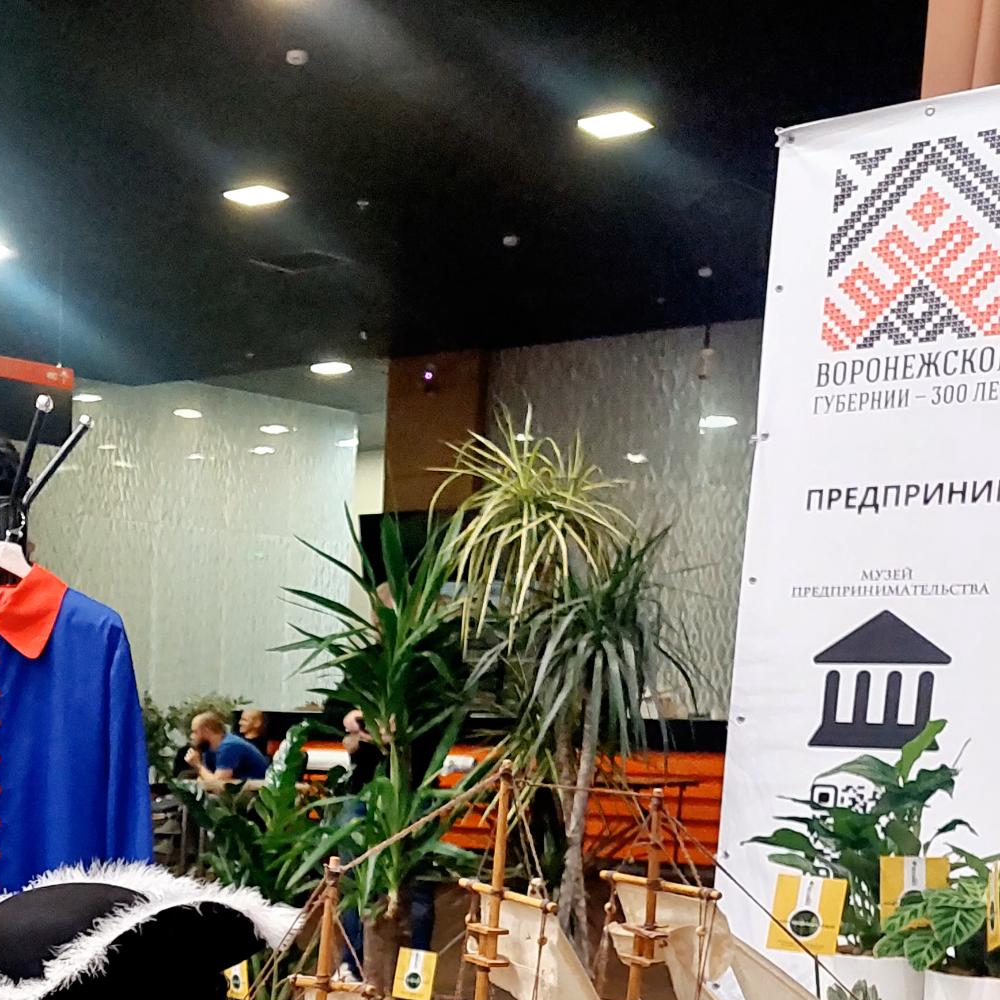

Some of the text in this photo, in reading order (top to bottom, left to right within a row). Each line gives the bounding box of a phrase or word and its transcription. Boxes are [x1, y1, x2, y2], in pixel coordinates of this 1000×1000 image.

[815, 346, 1000, 388] ВОРОНЕЖСКО
[813, 388, 910, 415] ГУБЕРНИИ
[931, 383, 968, 406] 300
[806, 479, 1000, 515] ПРЕДПРИНИ
[860, 566, 913, 582] МУЗЕЙ
[791, 583, 990, 599] ПРЕДПРИНИМАТЕЛЬСТВА
